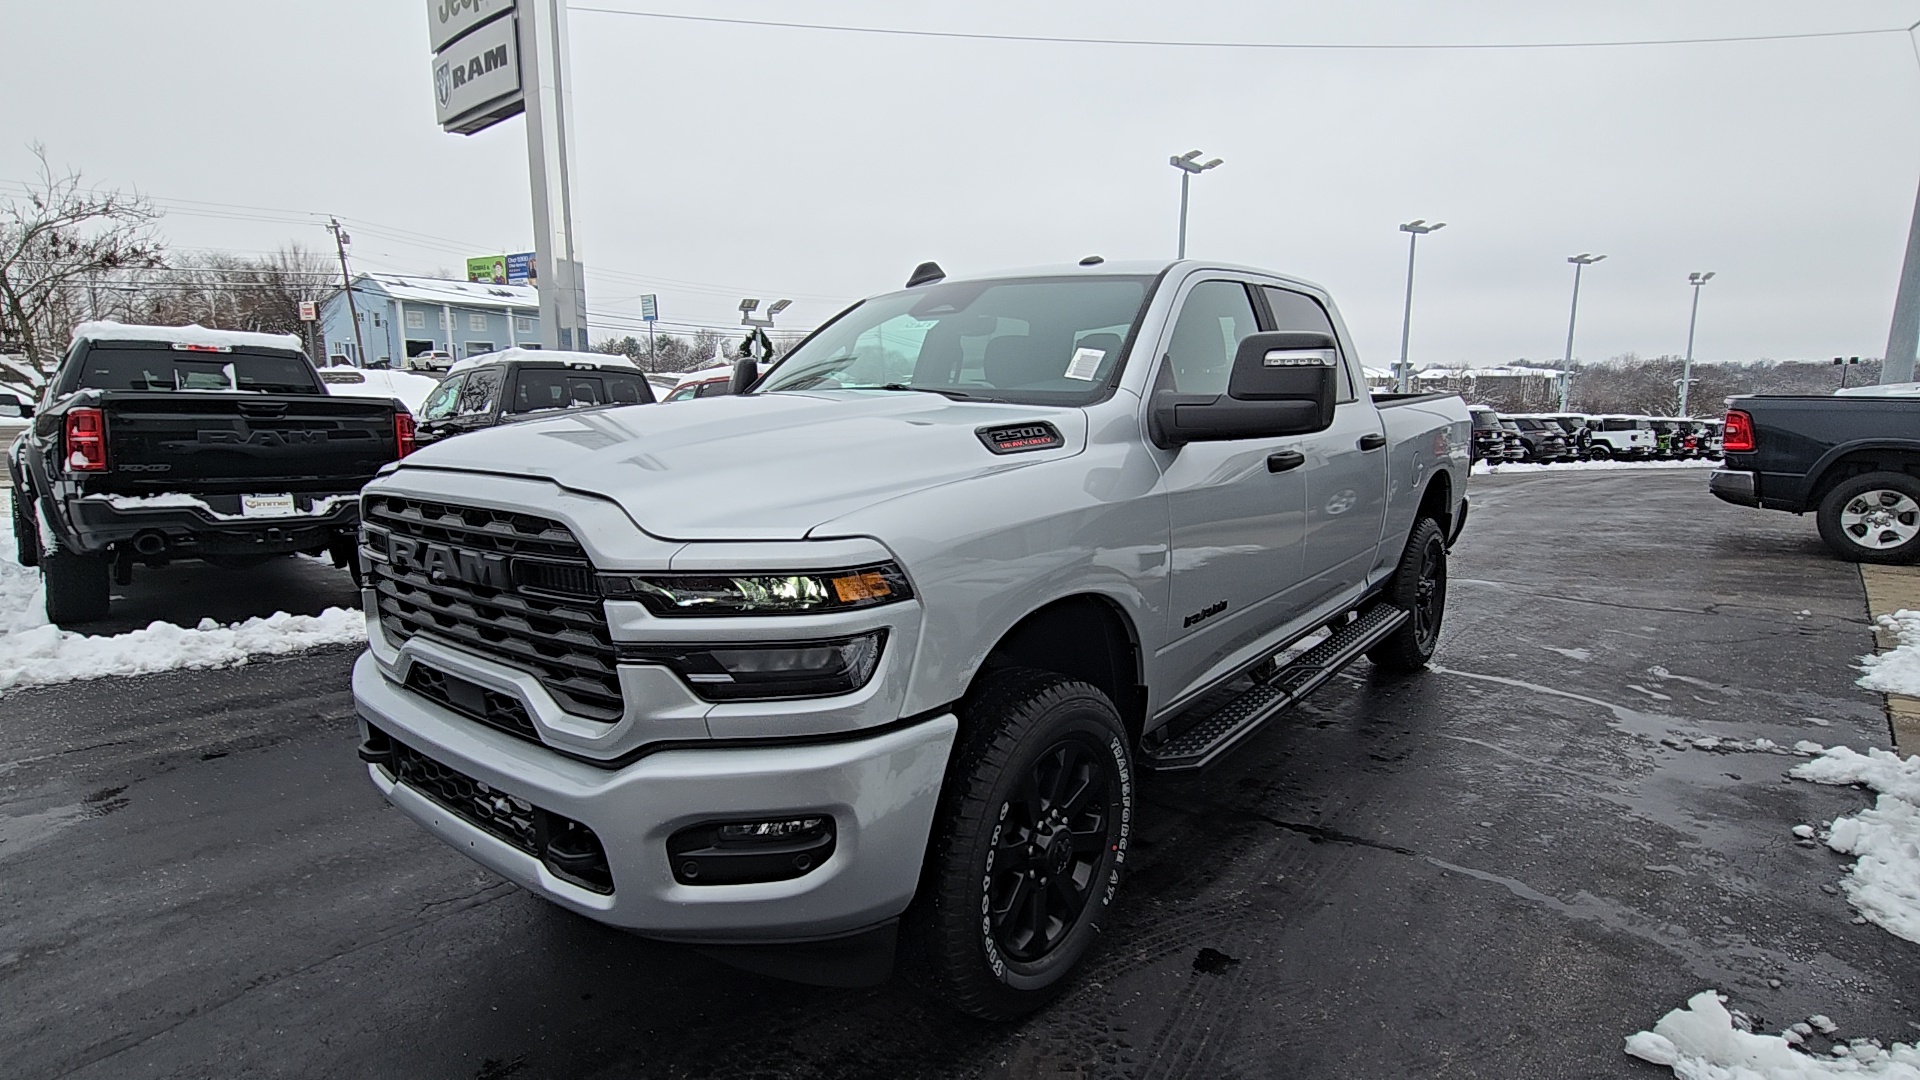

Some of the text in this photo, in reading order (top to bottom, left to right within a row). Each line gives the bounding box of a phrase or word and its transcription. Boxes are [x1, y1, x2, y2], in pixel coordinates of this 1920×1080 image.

[452, 43, 508, 90] RAM
[196, 429, 328, 445] RAM
[994, 426, 1047, 441] 2500
[999, 437, 1052, 449] HEAVY DUTY
[387, 534, 512, 591] RAM
